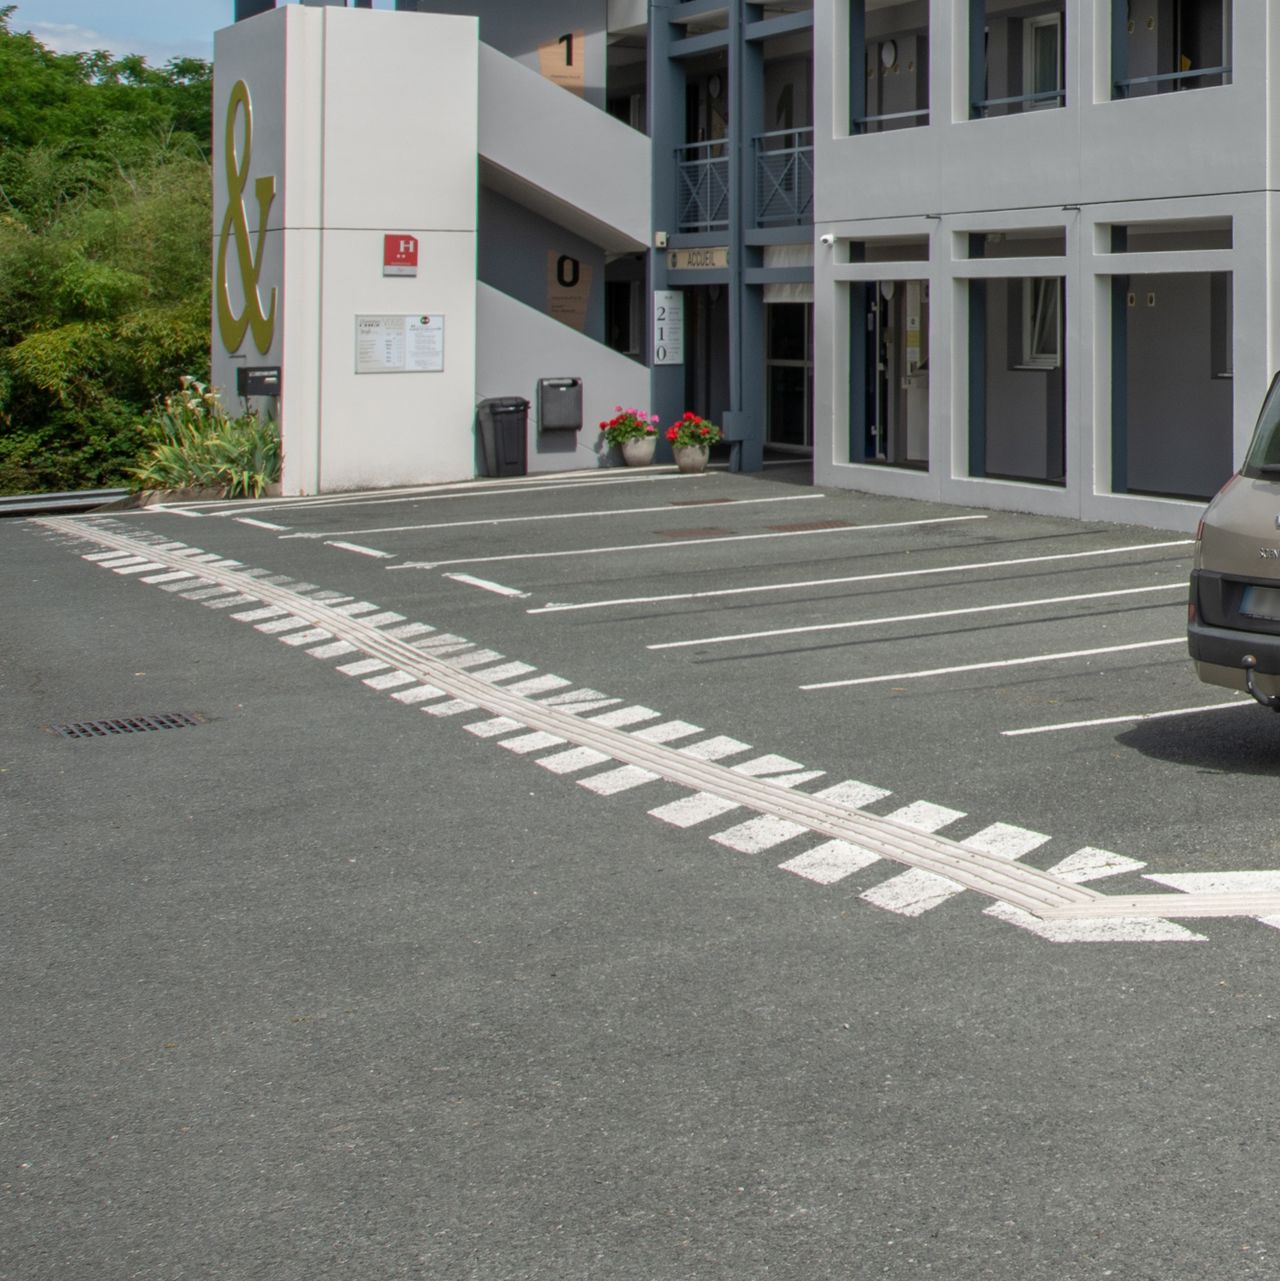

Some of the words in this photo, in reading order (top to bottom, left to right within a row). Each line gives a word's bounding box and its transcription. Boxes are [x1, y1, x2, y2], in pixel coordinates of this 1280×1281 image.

[558, 32, 574, 67] 1
[400, 239, 414, 253] H
[687, 251, 716, 267] ACCUEIL
[656, 306, 666, 321] 2
[658, 327, 665, 341] 1
